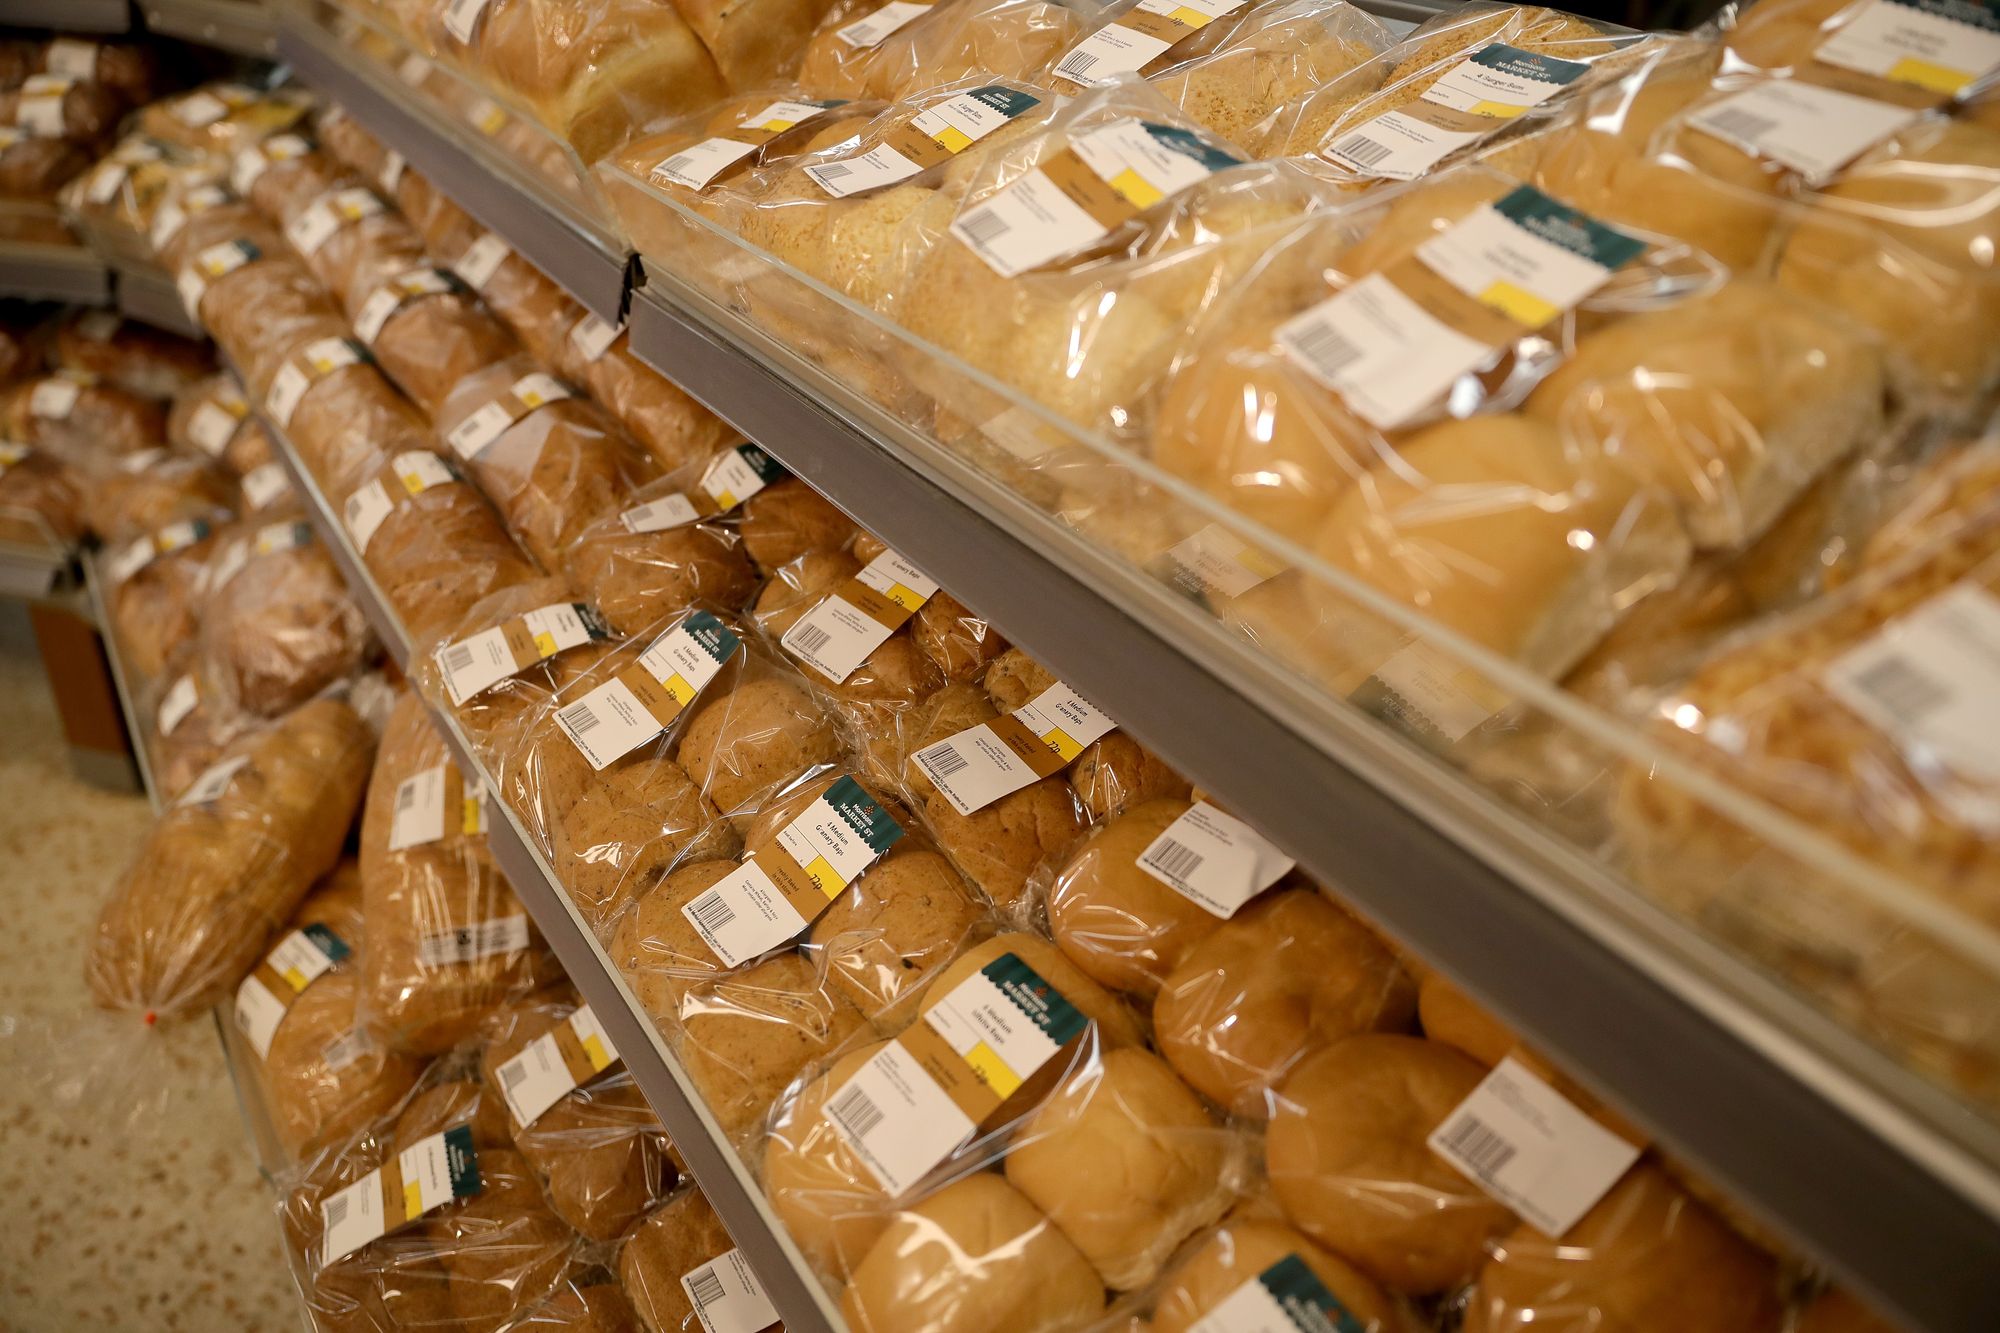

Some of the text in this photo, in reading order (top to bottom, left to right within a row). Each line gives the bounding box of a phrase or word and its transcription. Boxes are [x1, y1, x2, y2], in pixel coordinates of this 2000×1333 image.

[1495, 61, 1538, 77] MARKET
[893, 595, 904, 607] 72p
[695, 629, 720, 653] MARKET ST
[665, 688, 677, 700] 72p
[1069, 702, 1087, 717] Medium
[1071, 715, 1083, 725] Baps
[1046, 740, 1060, 754] 72p
[840, 803, 874, 837] MARKET ST
[852, 804, 873, 825] Morrisons
[815, 824, 844, 856] Granary Baps
[830, 825, 848, 845] Medium
[808, 873, 823, 890] 72p
